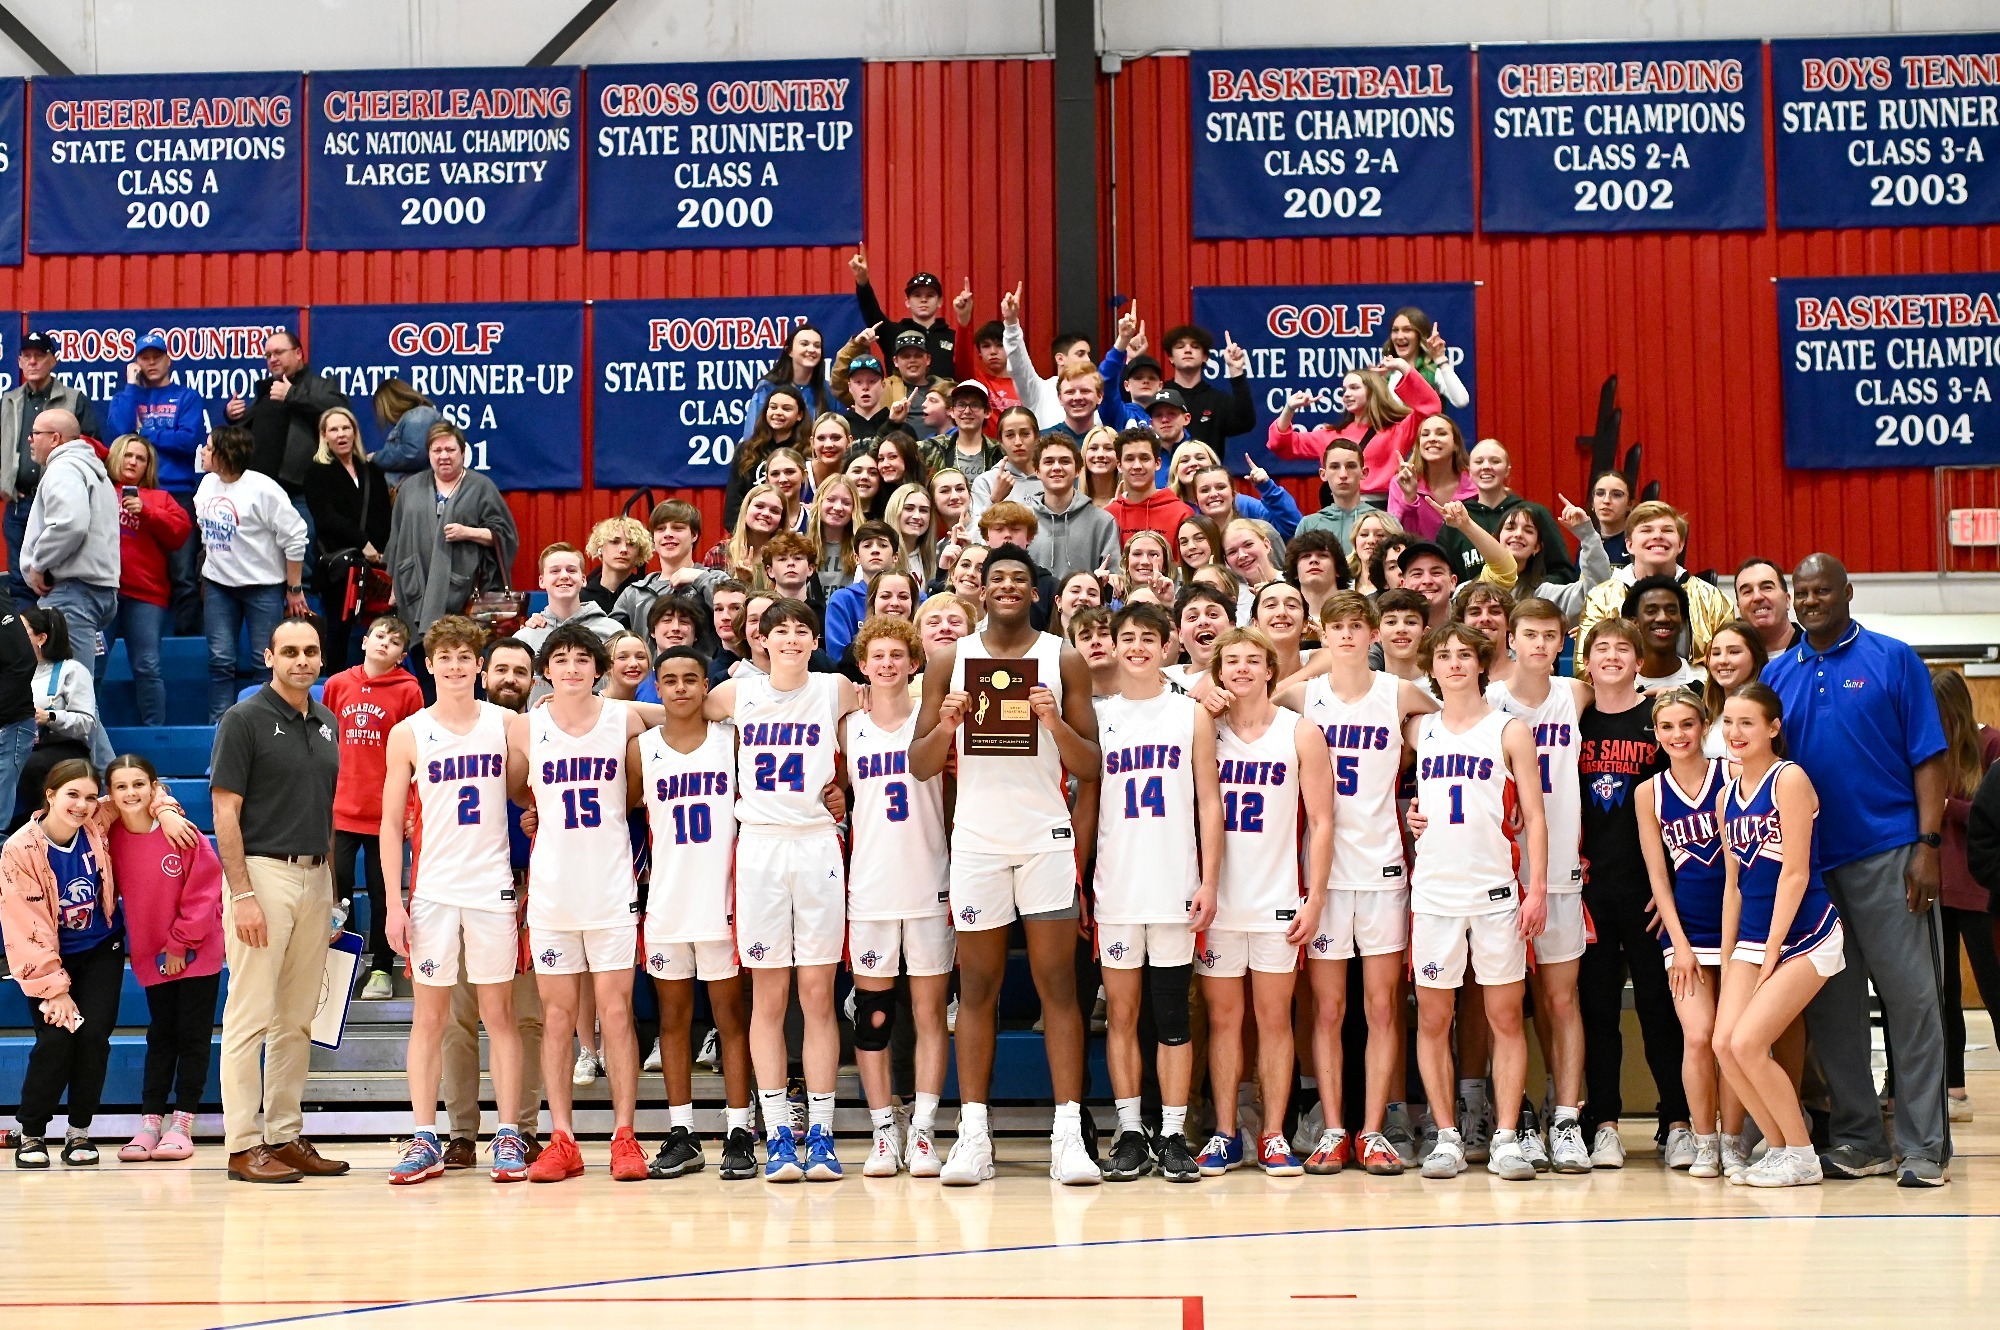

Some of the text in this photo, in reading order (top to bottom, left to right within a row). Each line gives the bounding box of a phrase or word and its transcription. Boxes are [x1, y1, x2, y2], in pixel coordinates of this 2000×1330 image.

[1208, 64, 1453, 101] BASKETBALL
[1499, 59, 1743, 97] CHEERLEADING
[1802, 56, 1892, 91] BOYS
[46, 95, 292, 131] CHEERLEADING
[323, 87, 571, 122] CHEERLEADING
[600, 78, 850, 117] CROSS COUNTRY
[1206, 106, 1455, 142] STATE CHAMPIONS
[1494, 101, 1746, 138] STATE CHAMPIONS
[1782, 101, 1868, 133] STATE
[51, 136, 285, 164] STATE CHAMPIONS
[324, 128, 570, 155] ASC NATIONAL CHAMPIONS
[598, 121, 853, 157] STATE RUNNER-UP
[1848, 137, 1984, 167] CLASS 3-A
[345, 160, 548, 185] LARGE VARSITY
[1264, 148, 1399, 176] CLASS 2-A
[1554, 143, 1690, 171] CLASS 2-A
[117, 169, 219, 196] CLASS A
[674, 161, 778, 188] CLASS A
[1870, 173, 1968, 206] 2003
[401, 197, 486, 225] 2000
[1284, 188, 1382, 218] 2002
[1574, 179, 1674, 211] 2002
[126, 201, 210, 229] 2000
[677, 197, 773, 228] 2000
[1267, 303, 1385, 338] GOLF
[148, 326, 285, 361] OUNTR
[389, 321, 504, 356] GOLF
[1795, 339, 1876, 372] STATE
[50, 371, 118, 401] TATE
[412, 364, 574, 396] RUNNER-UP
[604, 361, 685, 393] STATE
[1855, 376, 1992, 406] CLASS 3-A
[480, 404, 498, 429] A
[1875, 413, 1974, 446] 2004
[1960, 511, 1998, 542] EXIT
[341, 703, 386, 720] OKLAHOMA
[345, 728, 380, 740] CHRISTIAN
[743, 722, 821, 746] SAINTS
[1318, 724, 1390, 751] AINTS
[1106, 744, 1181, 775] SAINTS
[1421, 754, 1494, 781] SAINTS
[1581, 760, 1640, 775] BASKETBALL
[1600, 739, 1657, 765] SAINTS
[428, 754, 502, 783] SAINTS
[542, 757, 618, 785] SAINTS
[755, 752, 805, 792] 24
[1216, 759, 1287, 786] AINTS
[1336, 756, 1359, 797] 5
[657, 771, 728, 802] SAINTS
[885, 781, 909, 822] 3
[1124, 776, 1165, 819] 14
[458, 785, 480, 825] 2
[562, 787, 601, 829] 15
[1223, 791, 1264, 833] 12
[1449, 784, 1465, 824] 1
[672, 802, 712, 845] 10
[1725, 816, 1783, 848] AINTS
